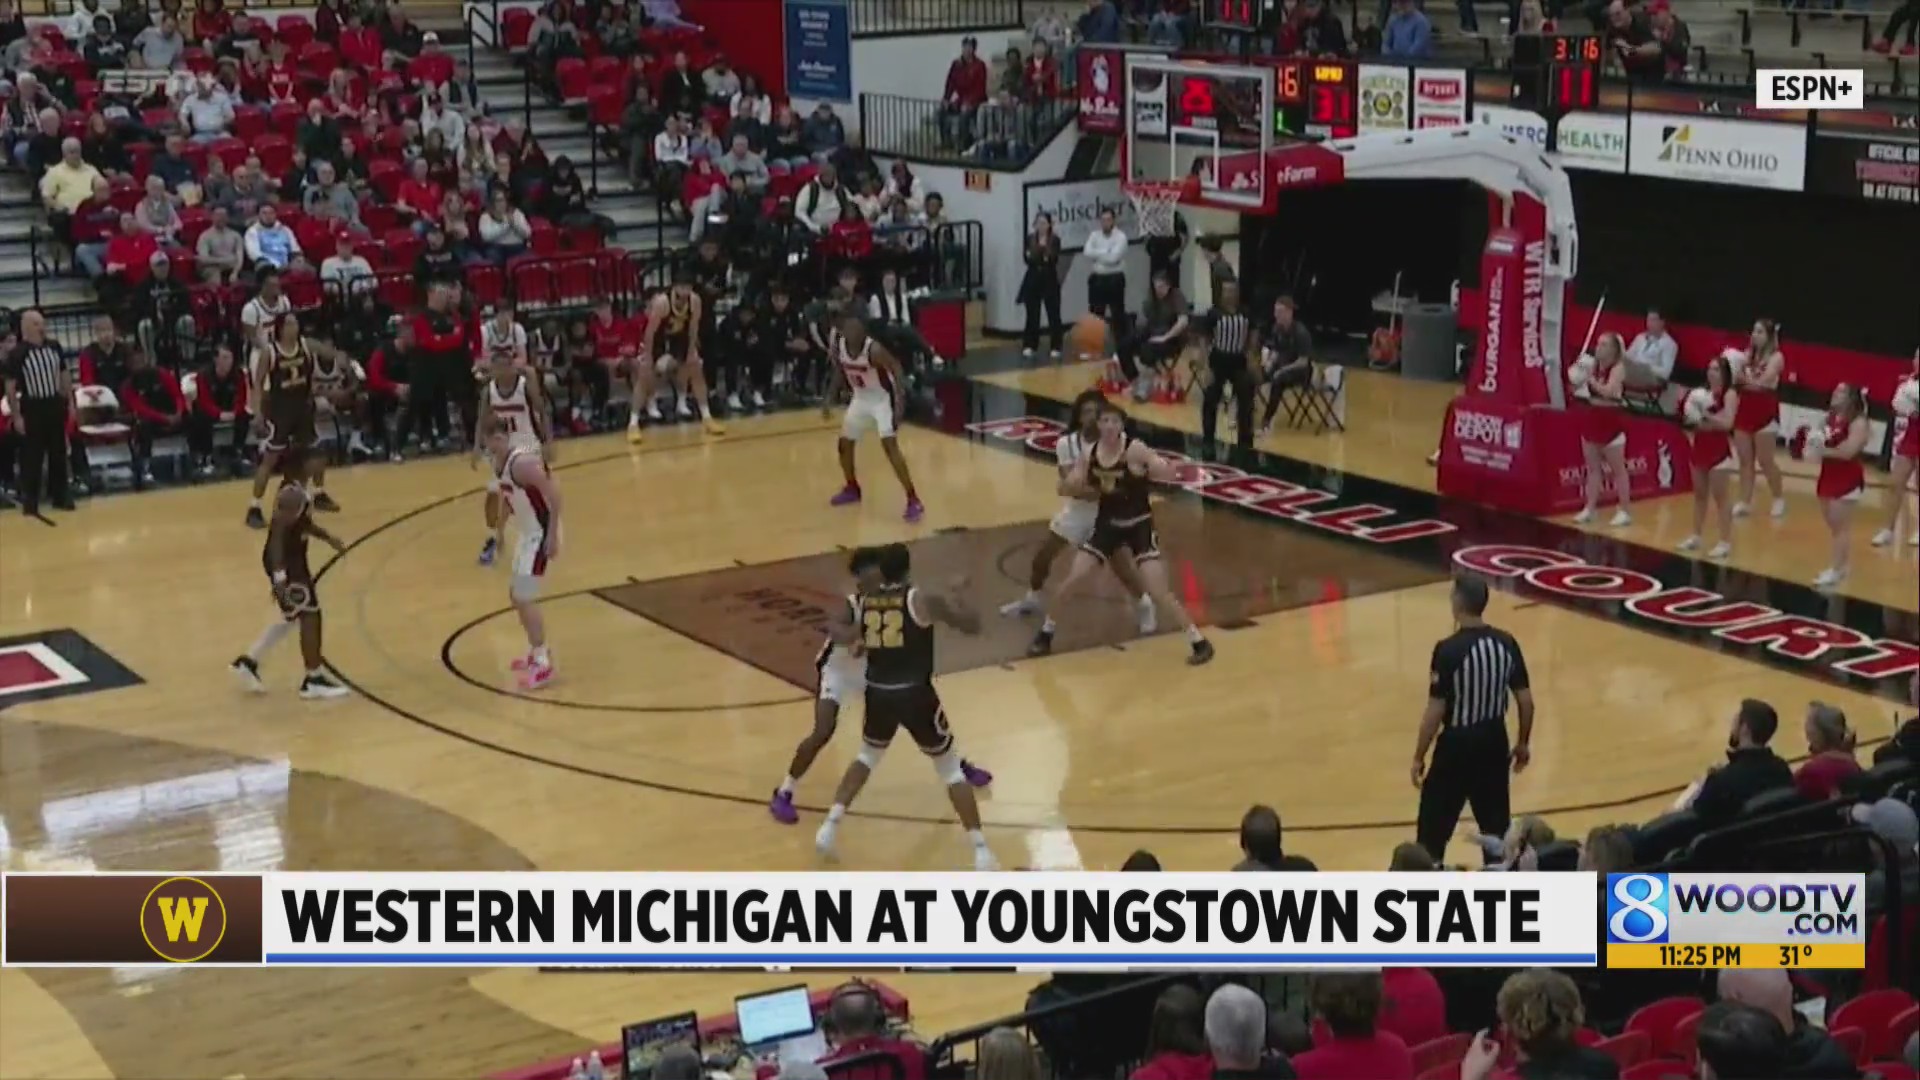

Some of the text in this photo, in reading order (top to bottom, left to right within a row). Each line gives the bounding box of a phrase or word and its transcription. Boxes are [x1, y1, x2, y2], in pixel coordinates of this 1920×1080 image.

[1558, 128, 1624, 151] HEALTH
[1675, 144, 1778, 172] PENN OHIO
[1452, 544, 1919, 679] COURT
